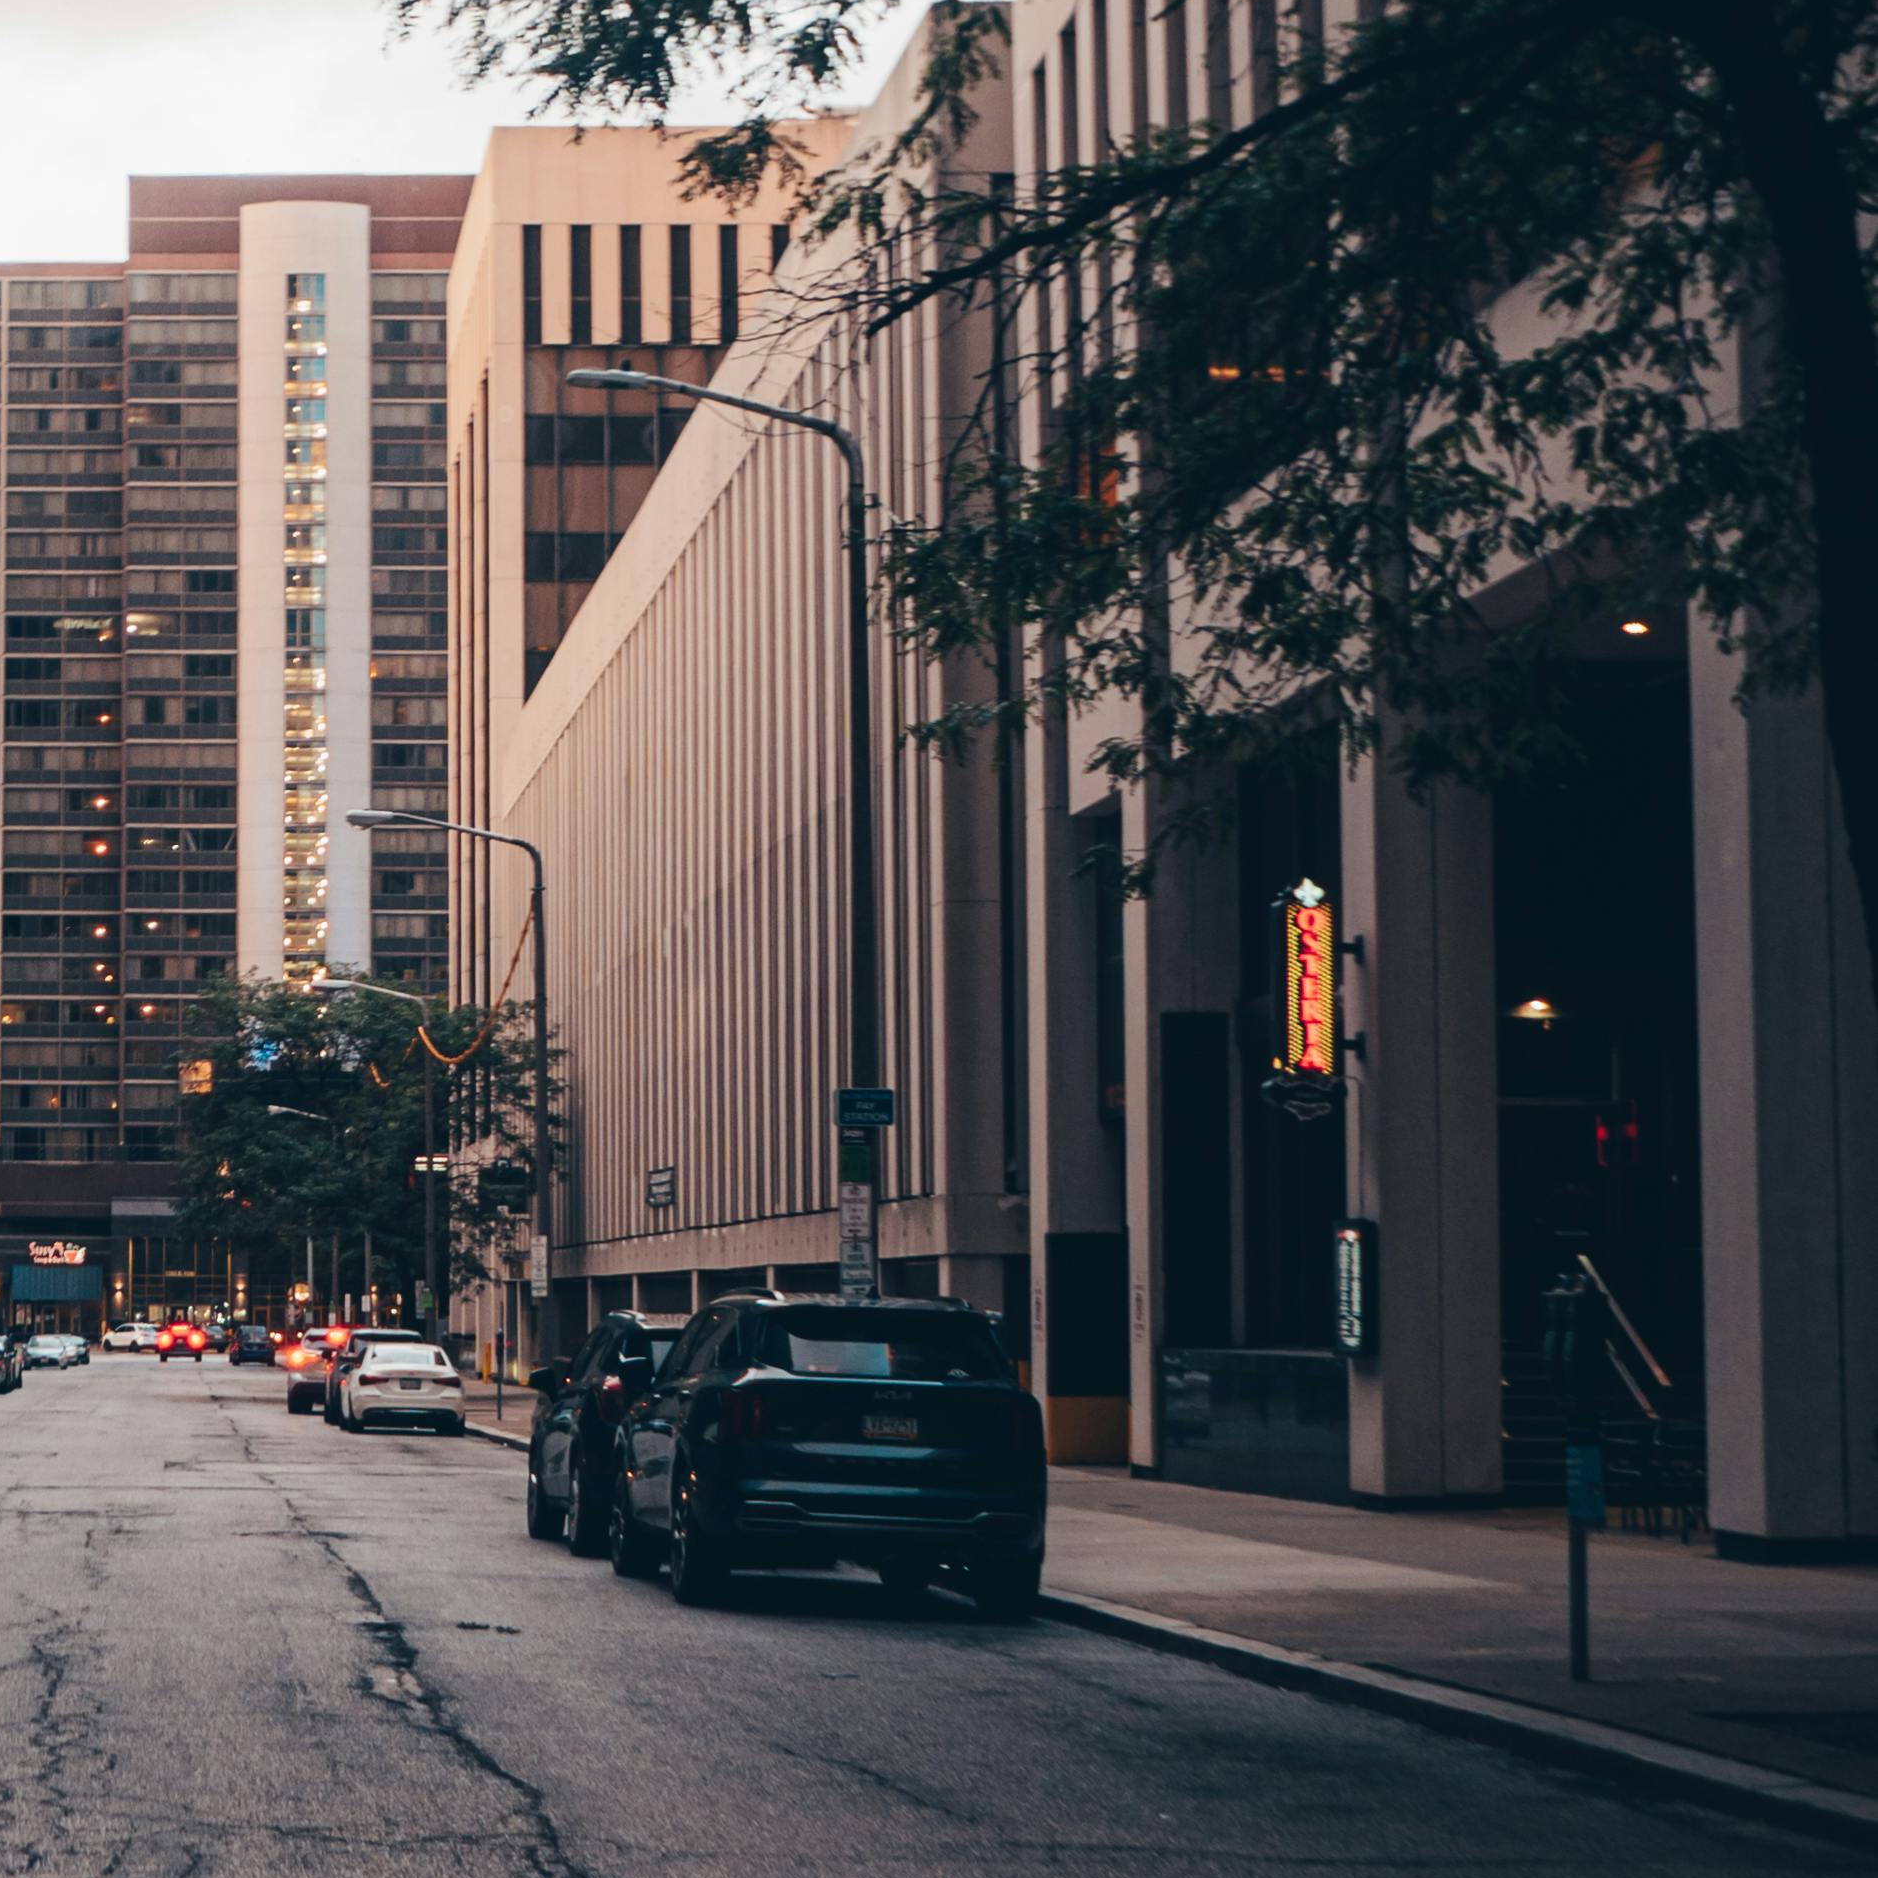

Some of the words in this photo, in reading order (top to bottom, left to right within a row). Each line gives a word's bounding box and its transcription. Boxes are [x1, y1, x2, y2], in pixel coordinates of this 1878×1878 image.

[1296, 908, 1324, 1070] OSTERIA
[856, 1101, 876, 1110] PAY
[842, 1112, 889, 1122] STATION
